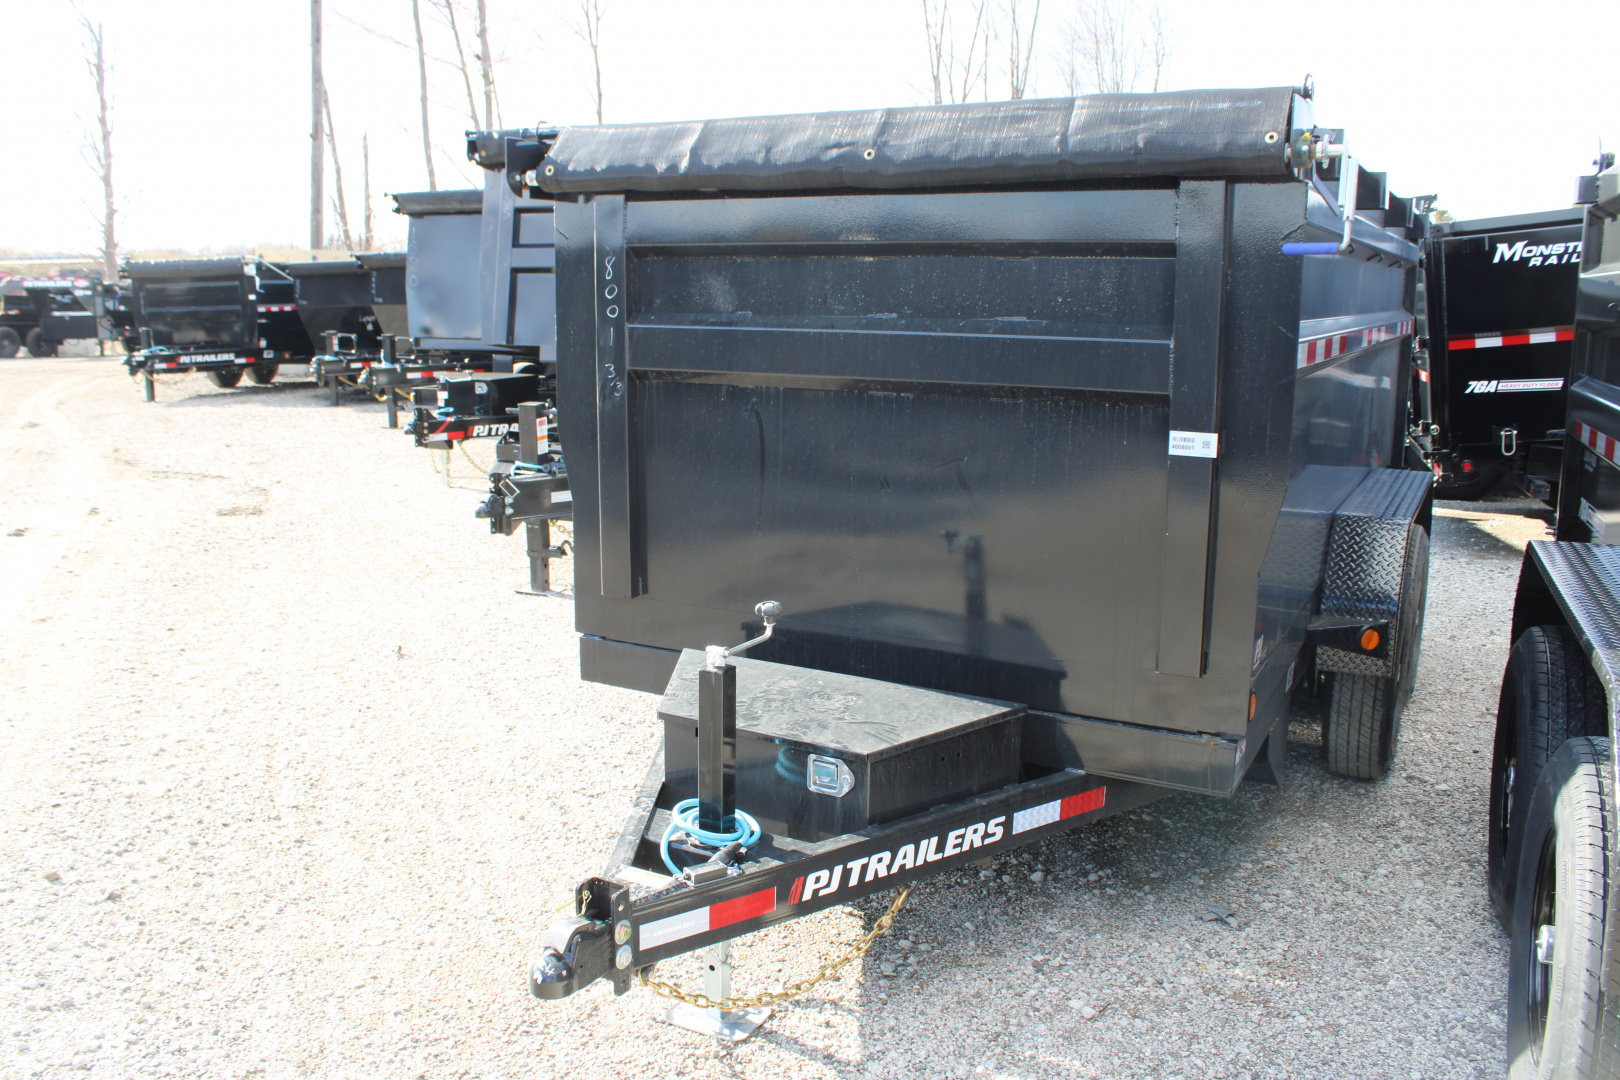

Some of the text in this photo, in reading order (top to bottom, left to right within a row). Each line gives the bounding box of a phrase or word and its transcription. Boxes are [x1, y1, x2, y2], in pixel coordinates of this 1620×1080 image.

[192, 352, 236, 363] TRAILERS
[1464, 379, 1498, 394] 7GA
[472, 424, 489, 437] PJ
[801, 815, 1007, 902] PJ TRAILERS
